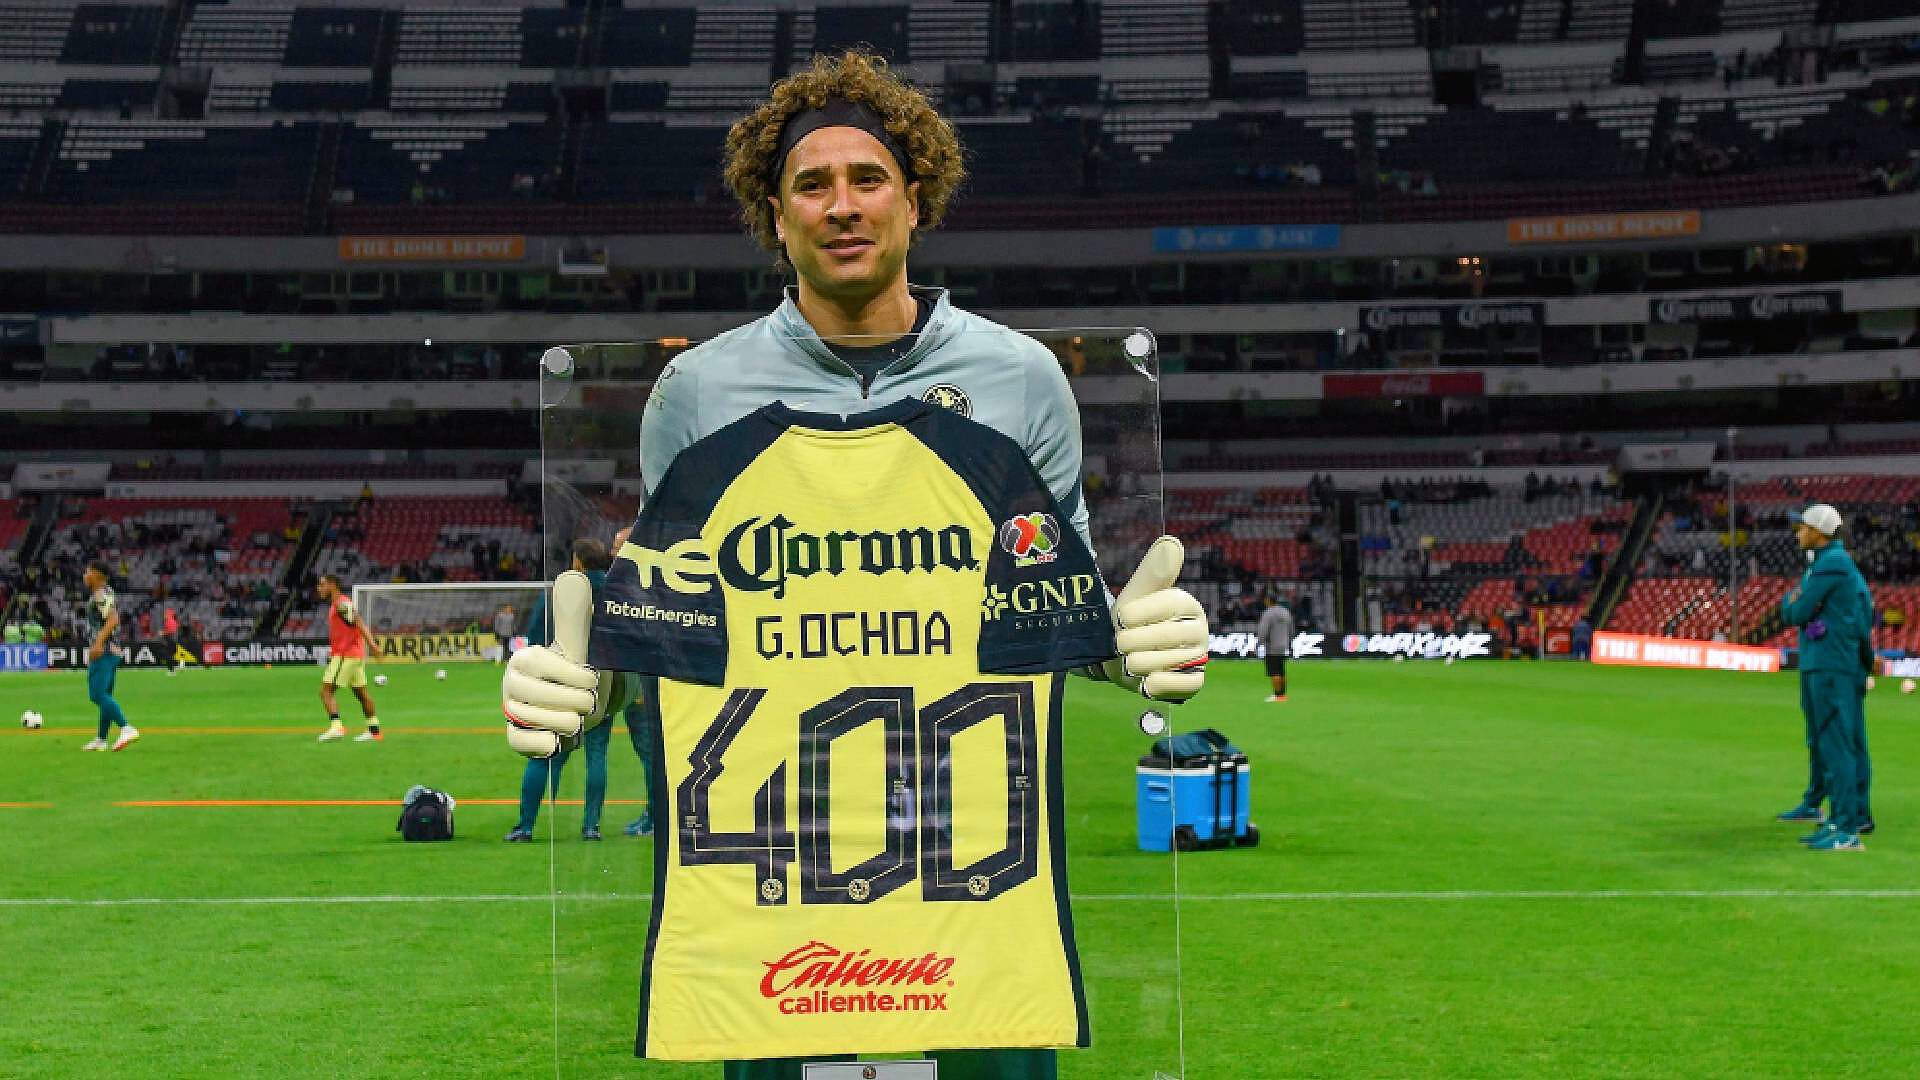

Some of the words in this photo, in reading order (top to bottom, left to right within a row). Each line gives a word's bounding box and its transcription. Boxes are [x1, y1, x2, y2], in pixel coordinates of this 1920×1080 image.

[1519, 220, 1555, 238] THE
[1563, 217, 1616, 237] HOME
[1622, 213, 1688, 234] DEPOT
[351, 239, 386, 257] THE
[392, 239, 448, 257] HOME
[453, 239, 513, 257] DEPOT
[718, 514, 980, 599] Corona
[1011, 574, 1094, 613] GNP
[604, 600, 717, 628] TotalEnergies
[372, 635, 482, 658] ARDAHL
[755, 610, 951, 660] G.OCHOA
[1597, 638, 1638, 660] THE
[1643, 643, 1700, 667] HOME
[1706, 648, 1772, 672] DEPOT
[677, 681, 1037, 906] 400
[759, 940, 955, 997] Caliente
[778, 990, 946, 1014] caliente.mx
